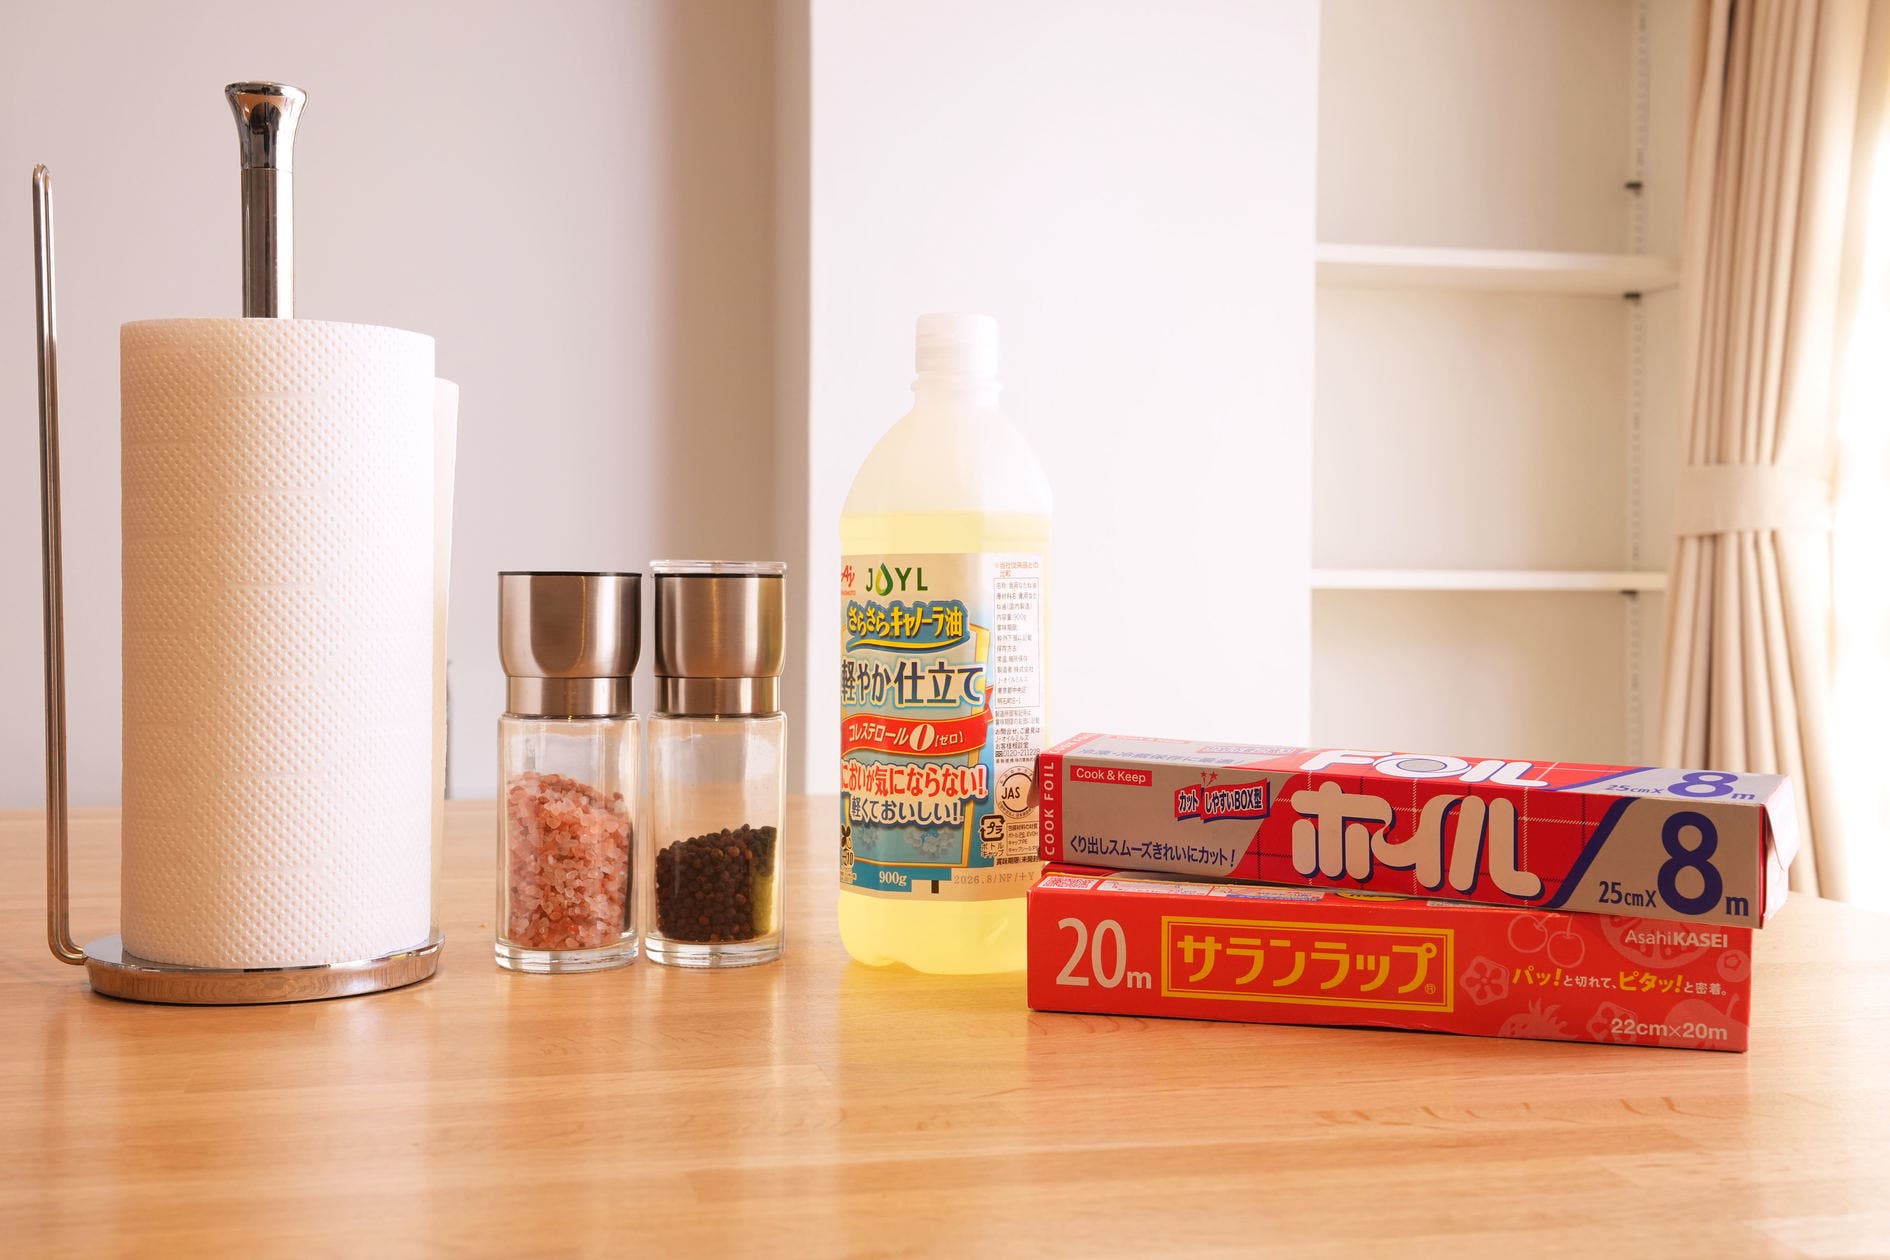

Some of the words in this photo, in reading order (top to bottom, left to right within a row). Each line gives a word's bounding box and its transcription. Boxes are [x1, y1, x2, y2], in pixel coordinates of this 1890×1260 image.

[849, 606, 963, 637] さらさらキャノーラ油
[842, 660, 984, 705] 軽やか仕立て
[1044, 762, 1055, 801] FOIL
[1076, 767, 1105, 781] Cook
[1107, 770, 1115, 780] &
[1118, 771, 1146, 784] Keep
[1300, 750, 1549, 788] FOIL
[1001, 786, 1021, 800] JAS
[1044, 809, 1055, 855] COOK
[1290, 781, 1545, 900] ホイル
[1070, 835, 1235, 867] くり出しスムーズきれいにカット!
[879, 870, 907, 887] 900g
[1055, 915, 1152, 989] 20m
[1625, 929, 1729, 948] AsahiKASEI
